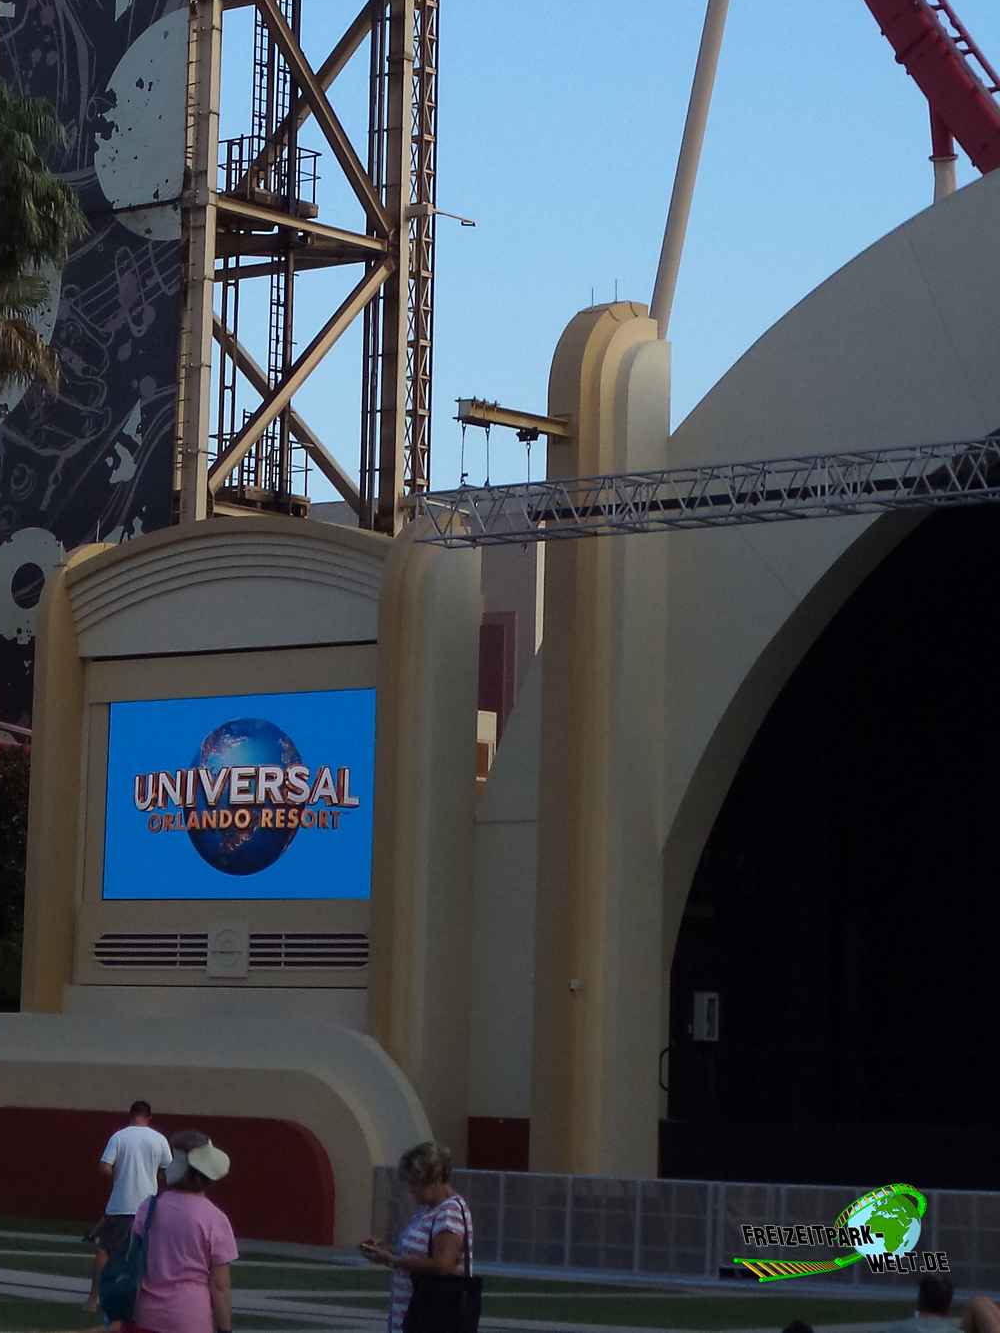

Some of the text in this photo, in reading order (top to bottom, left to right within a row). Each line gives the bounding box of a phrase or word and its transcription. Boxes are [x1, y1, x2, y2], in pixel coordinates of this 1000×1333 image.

[135, 765, 360, 810] UNIVERSAL
[148, 808, 341, 833] ORLANDO RESORT
